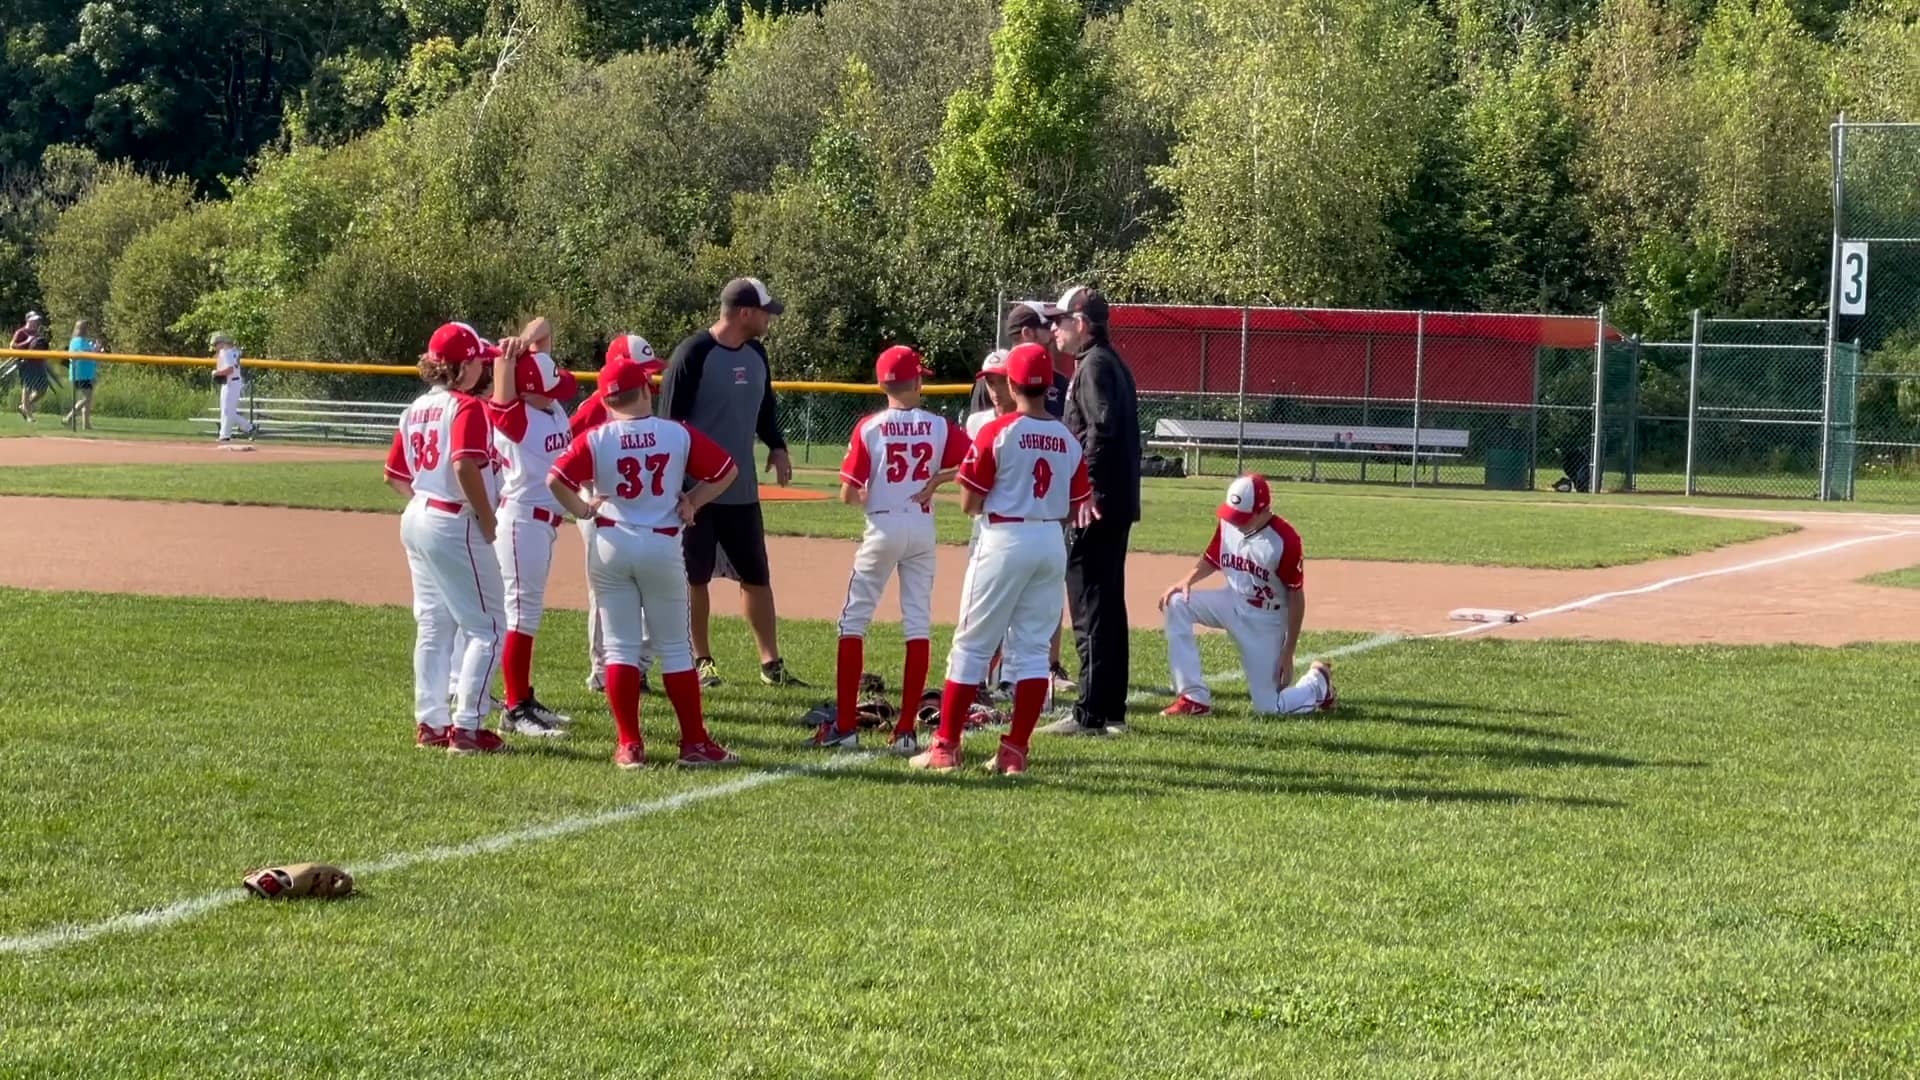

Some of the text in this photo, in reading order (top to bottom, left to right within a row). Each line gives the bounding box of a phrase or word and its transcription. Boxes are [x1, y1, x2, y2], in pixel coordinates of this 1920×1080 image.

[1845, 252, 1863, 304] 3
[620, 432, 656, 450] ELLIS
[880, 421, 932, 436] WOLFLEY
[1019, 433, 1067, 453] JOHNSON
[616, 452, 670, 500] 37
[886, 442, 933, 483] 52
[1032, 457, 1053, 499] 9
